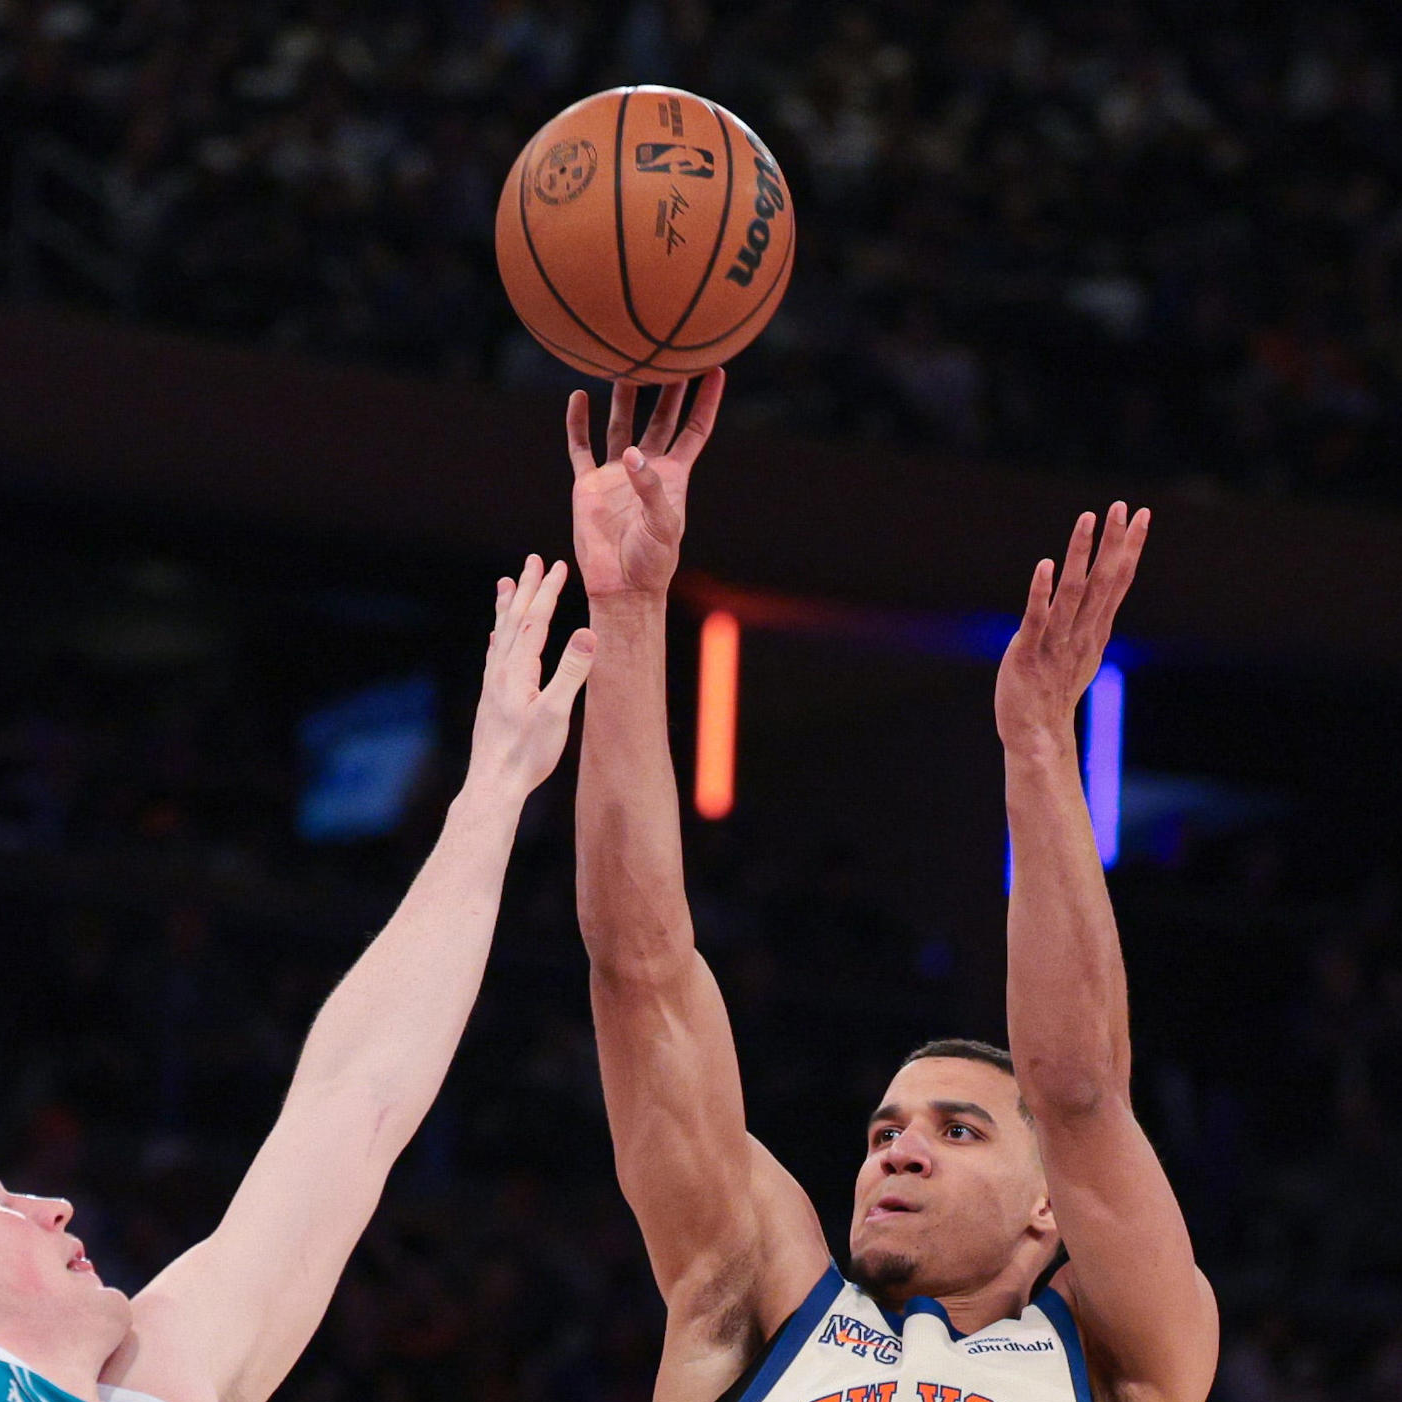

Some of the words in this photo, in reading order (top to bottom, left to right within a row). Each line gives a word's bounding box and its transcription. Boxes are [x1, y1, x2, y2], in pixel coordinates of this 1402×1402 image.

[724, 130, 784, 287] ilson
[818, 1314, 902, 1365] NYC
[968, 1343, 1002, 1354] abu
[1004, 1338, 1054, 1352] dhabi
